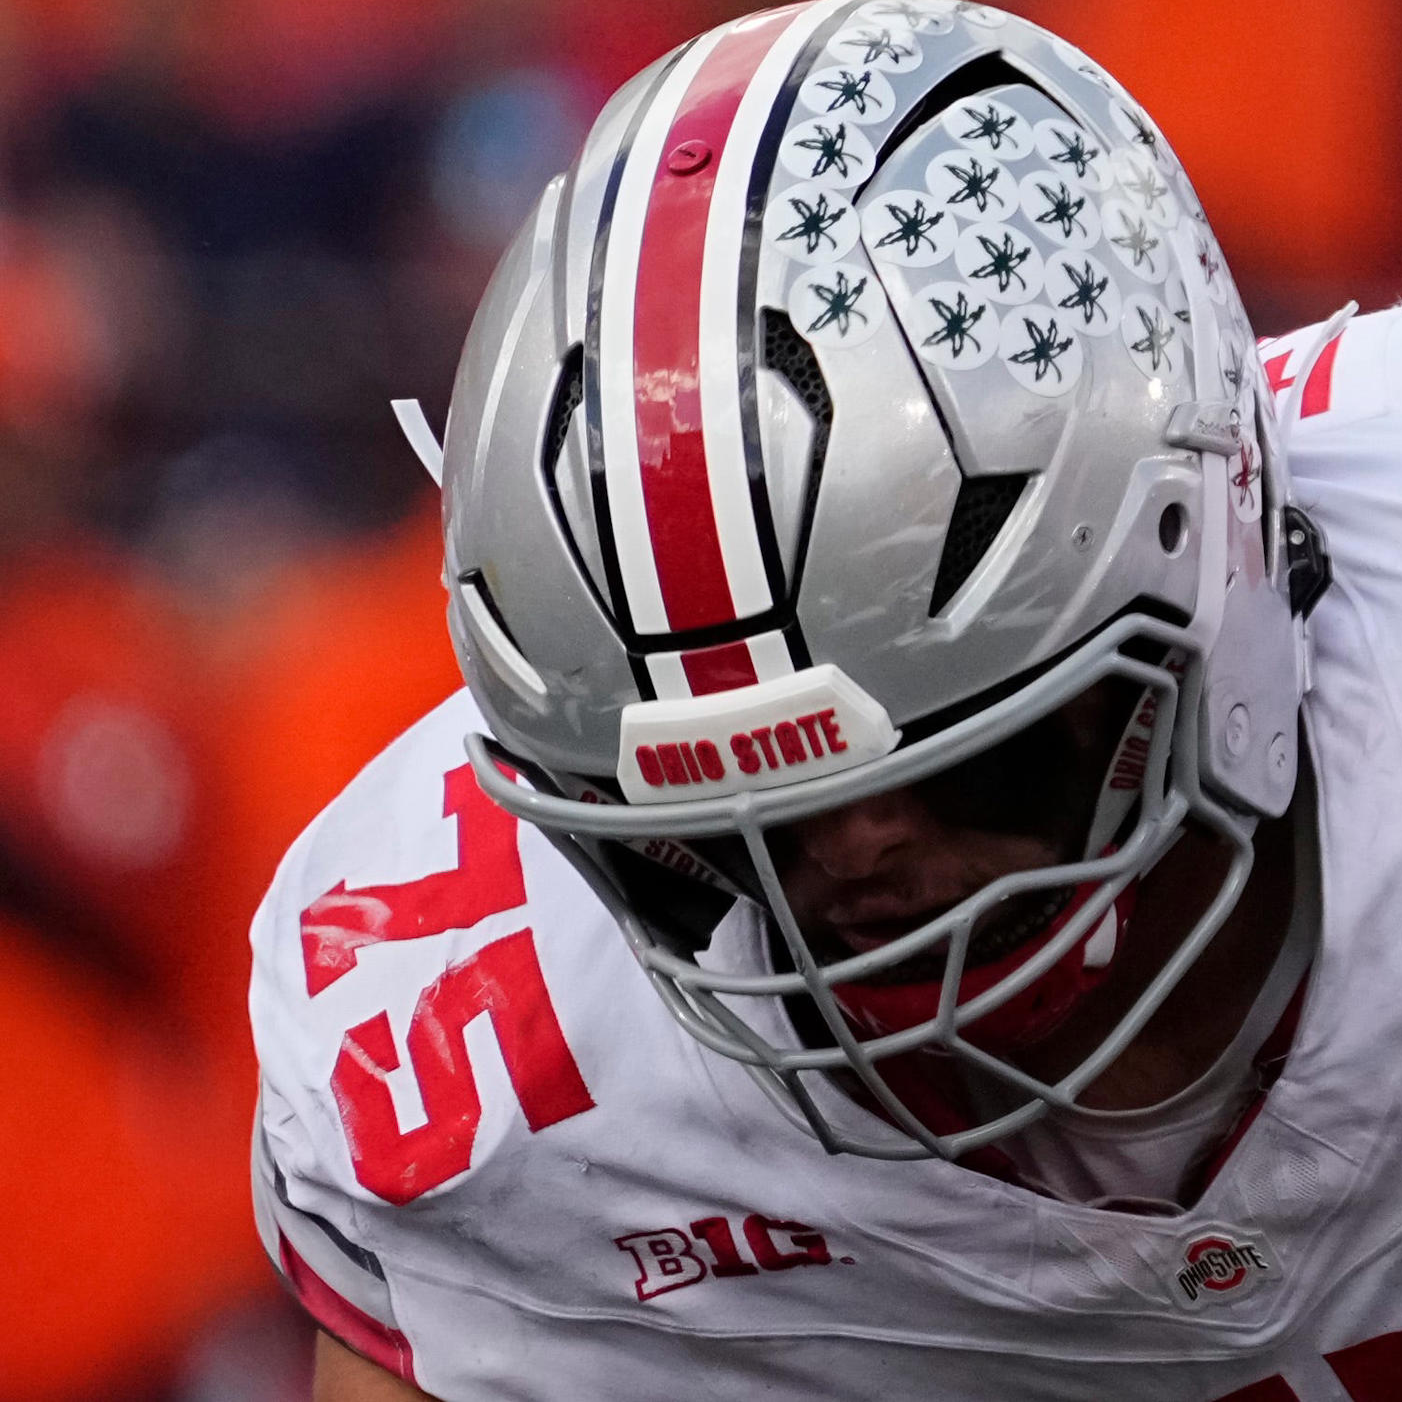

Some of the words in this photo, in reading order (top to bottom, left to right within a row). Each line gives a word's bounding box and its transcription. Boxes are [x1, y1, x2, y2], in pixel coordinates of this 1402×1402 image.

[636, 739, 726, 788] OHIO
[730, 708, 848, 775] STATE
[301, 760, 597, 1206] 75
